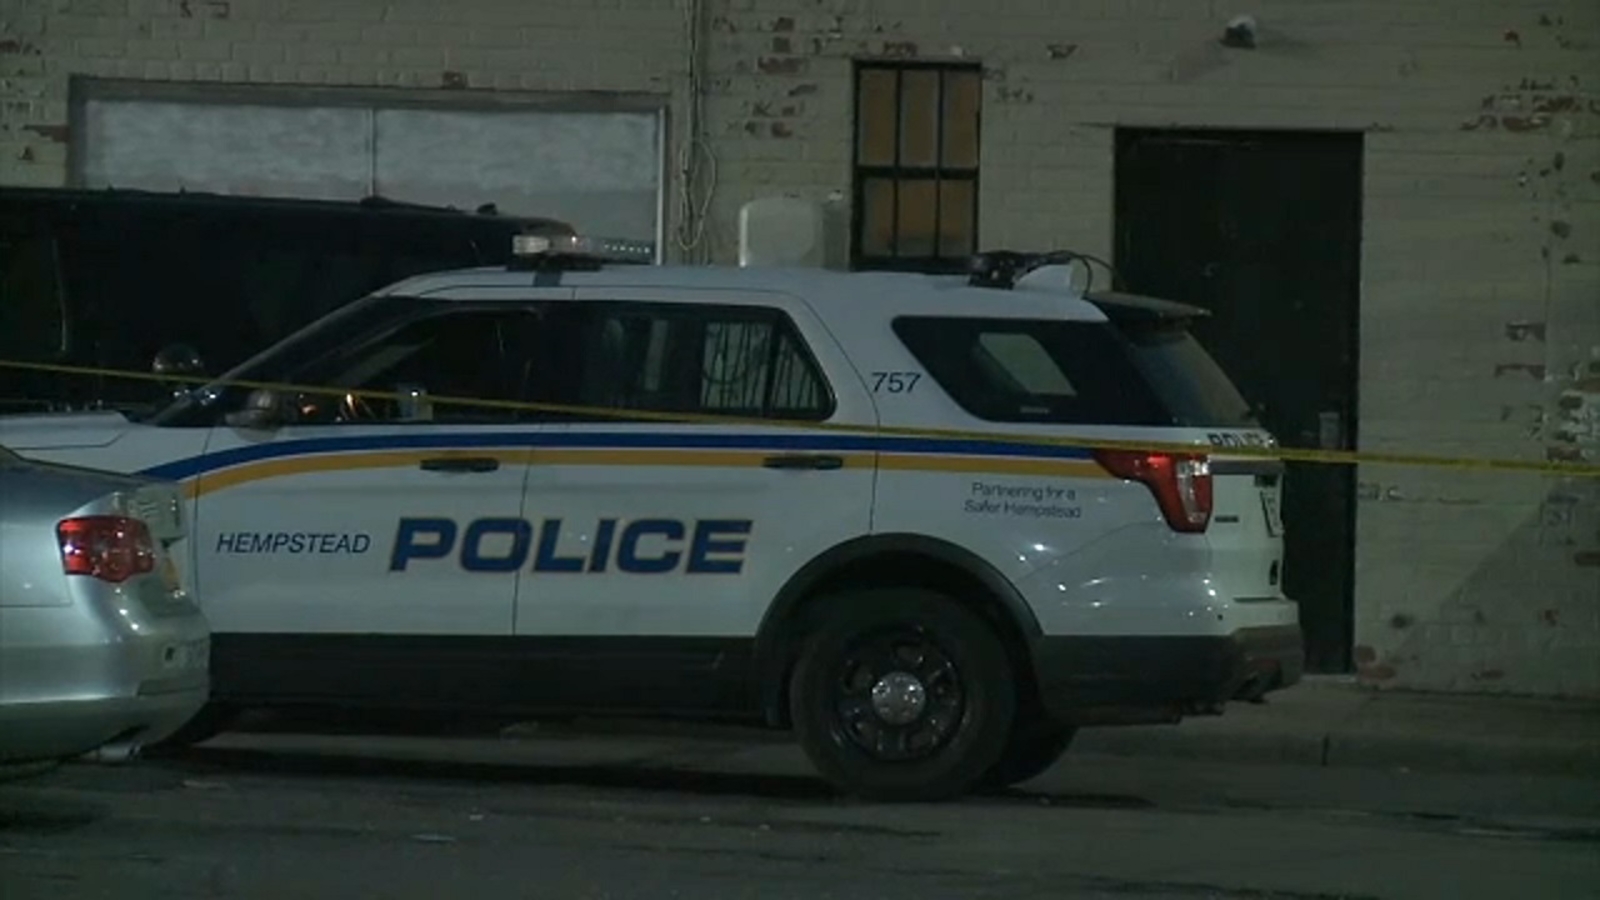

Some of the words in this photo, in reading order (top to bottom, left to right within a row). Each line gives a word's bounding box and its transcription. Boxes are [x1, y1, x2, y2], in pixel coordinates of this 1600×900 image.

[871, 372, 921, 393] 757
[971, 482, 1043, 502] Partnering
[1046, 486, 1063, 498] for
[1066, 489, 1076, 501] a
[964, 499, 1000, 514] Safer
[1003, 501, 1081, 518] Hempstead
[216, 532, 371, 554] HEMPSTEAD
[389, 518, 754, 574] POLICE
